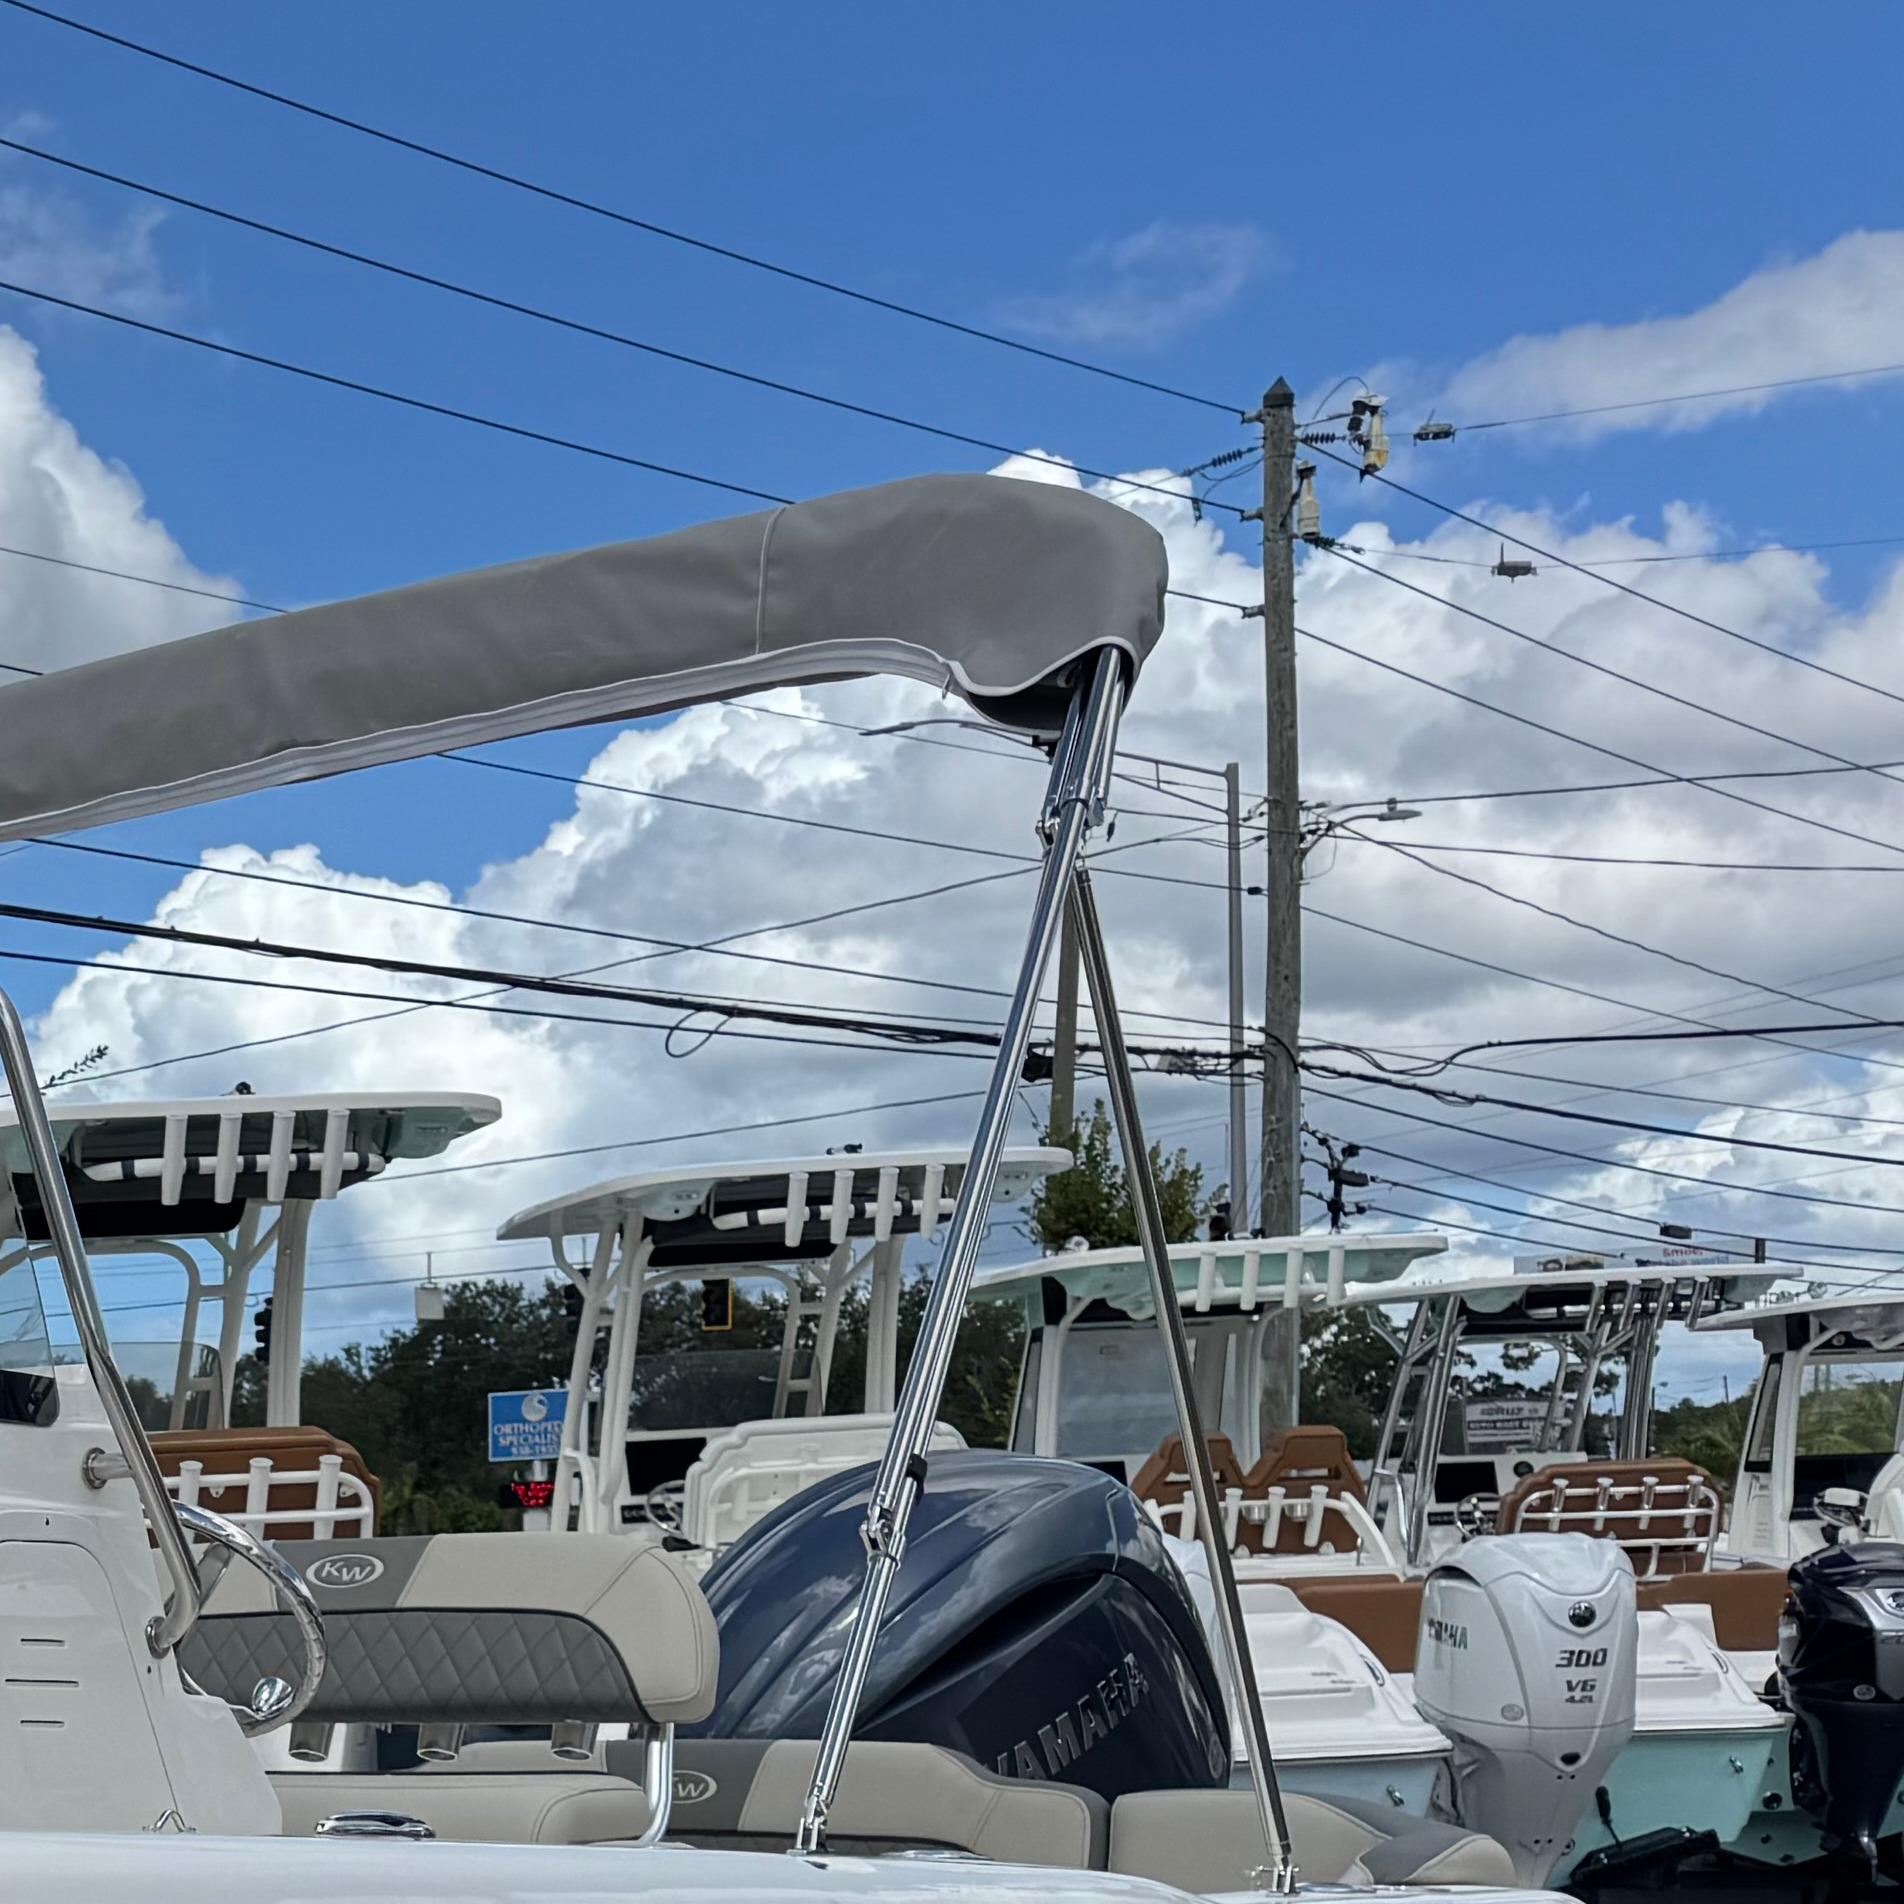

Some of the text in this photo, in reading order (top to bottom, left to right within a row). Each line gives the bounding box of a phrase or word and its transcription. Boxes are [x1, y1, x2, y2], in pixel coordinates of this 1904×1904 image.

[494, 1421, 563, 1435] ORTHOPED
[499, 1433, 561, 1447] SPECIALIS
[1555, 1647, 1609, 1668] 300
[1565, 1678, 1597, 1693] V6
